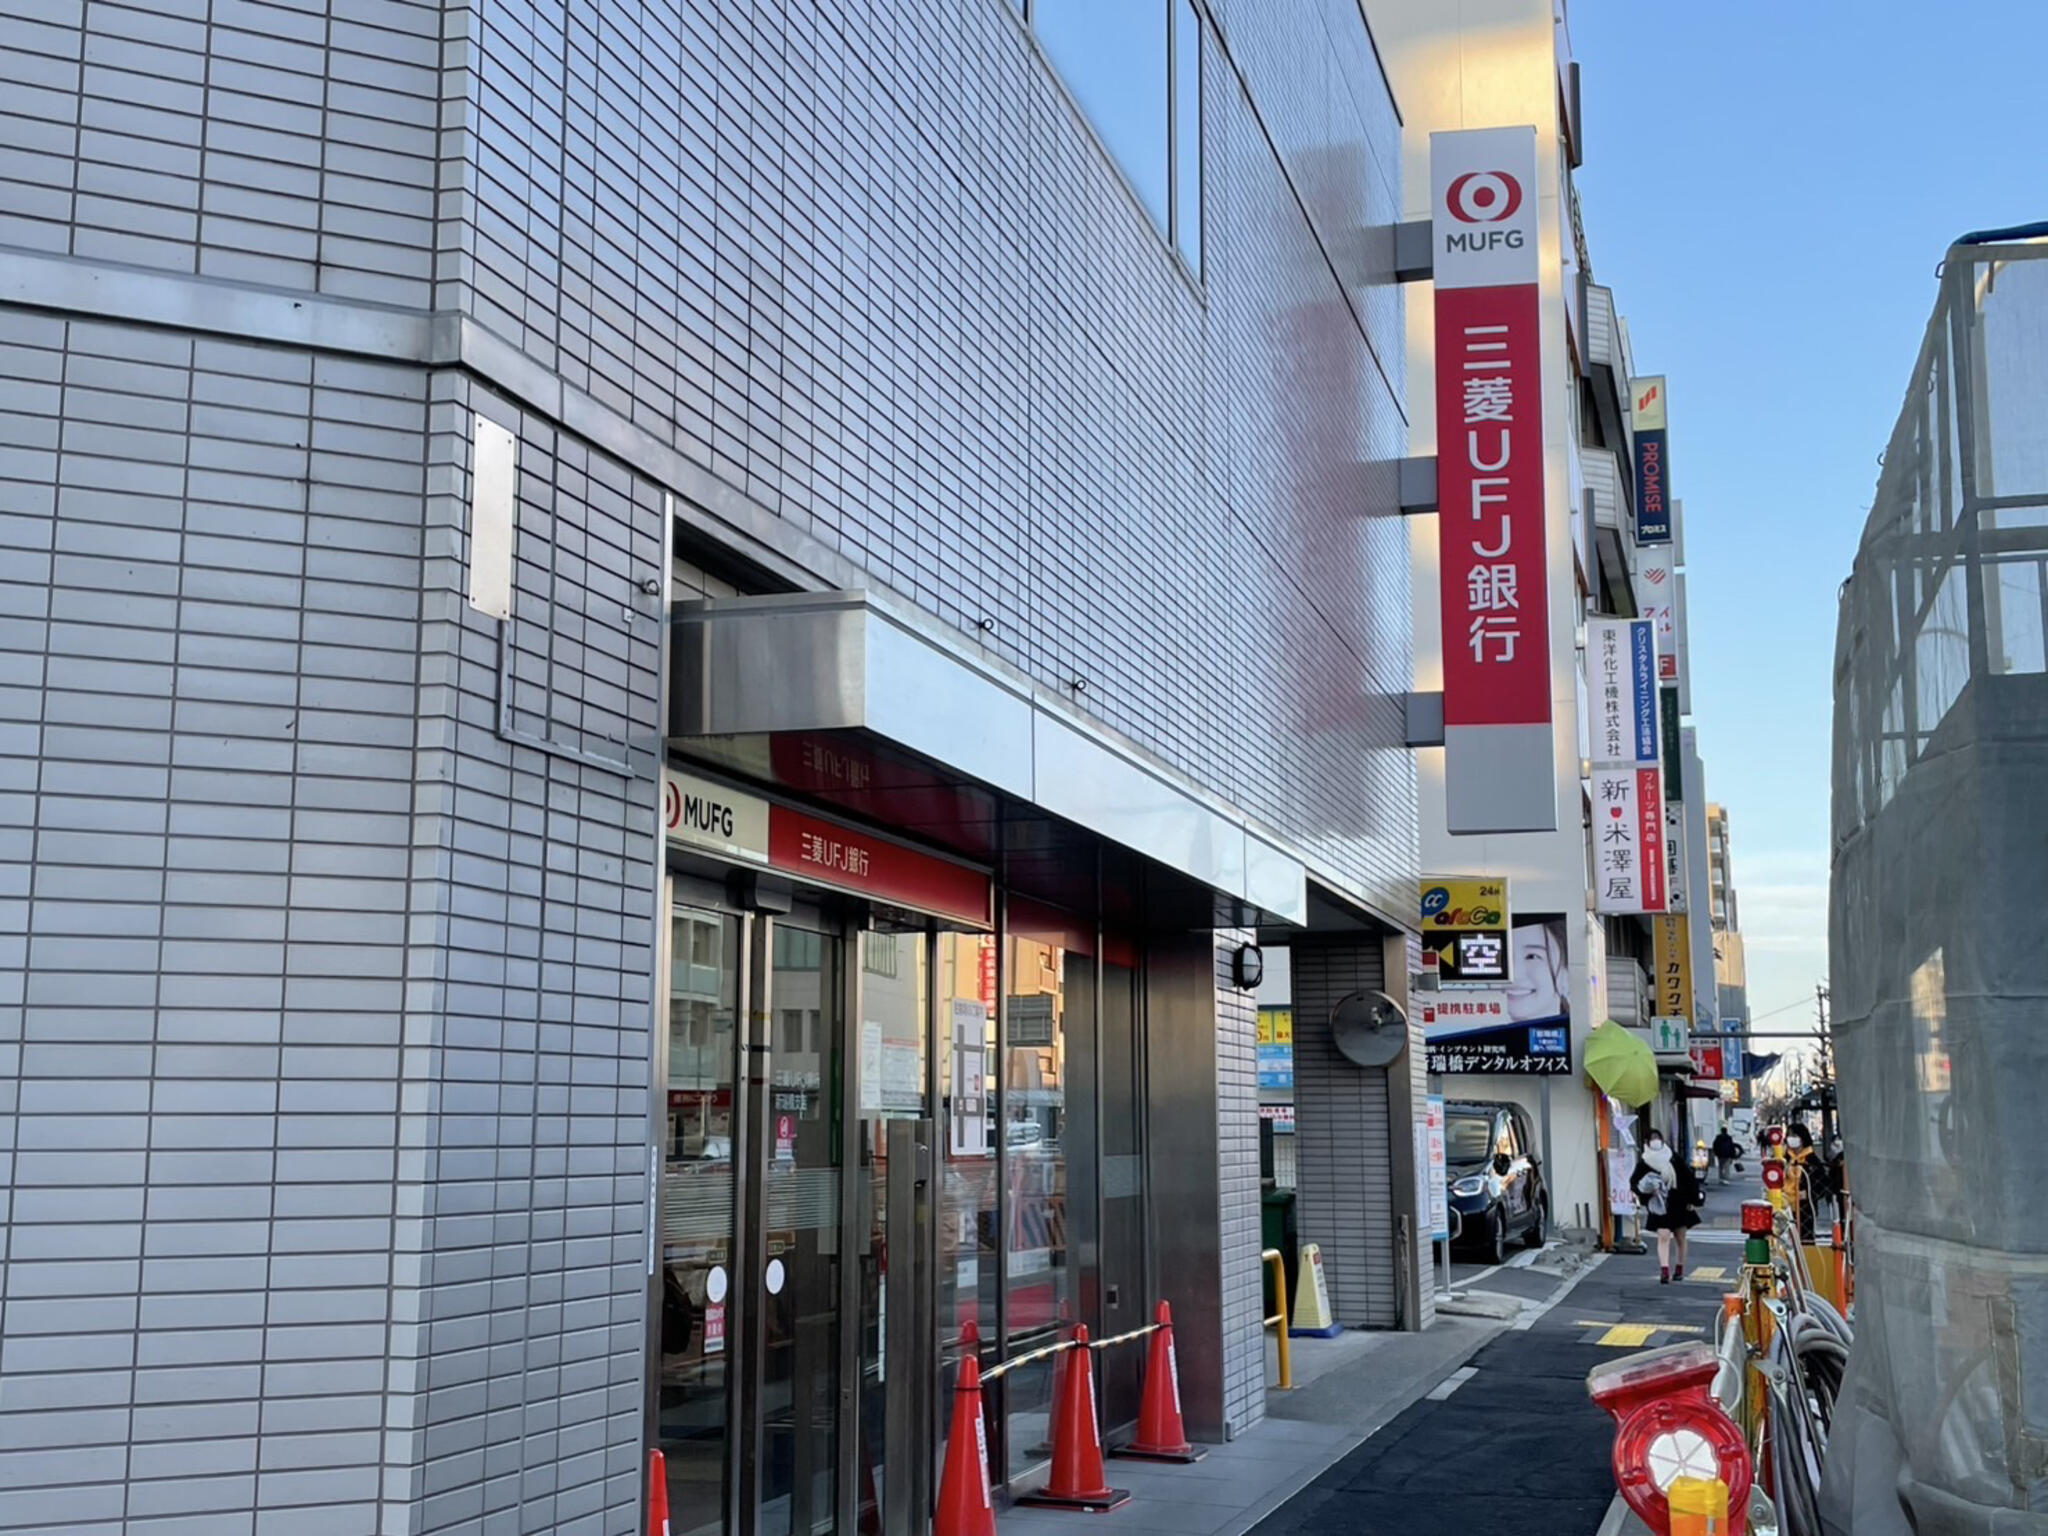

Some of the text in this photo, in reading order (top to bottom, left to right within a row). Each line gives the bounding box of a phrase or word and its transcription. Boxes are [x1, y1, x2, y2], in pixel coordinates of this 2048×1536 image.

[1446, 229, 1524, 253] MUFG
[1463, 324, 1521, 663] 三菱UFJ銀行
[1642, 441, 1663, 513] PROMISE
[1640, 524, 1667, 534] プロミス
[1602, 629, 1621, 756] 東洋化工機株式会社
[684, 793, 734, 838] MUFG
[801, 832, 870, 878] 三菱UFJ銀行
[1461, 933, 1503, 974] 空
